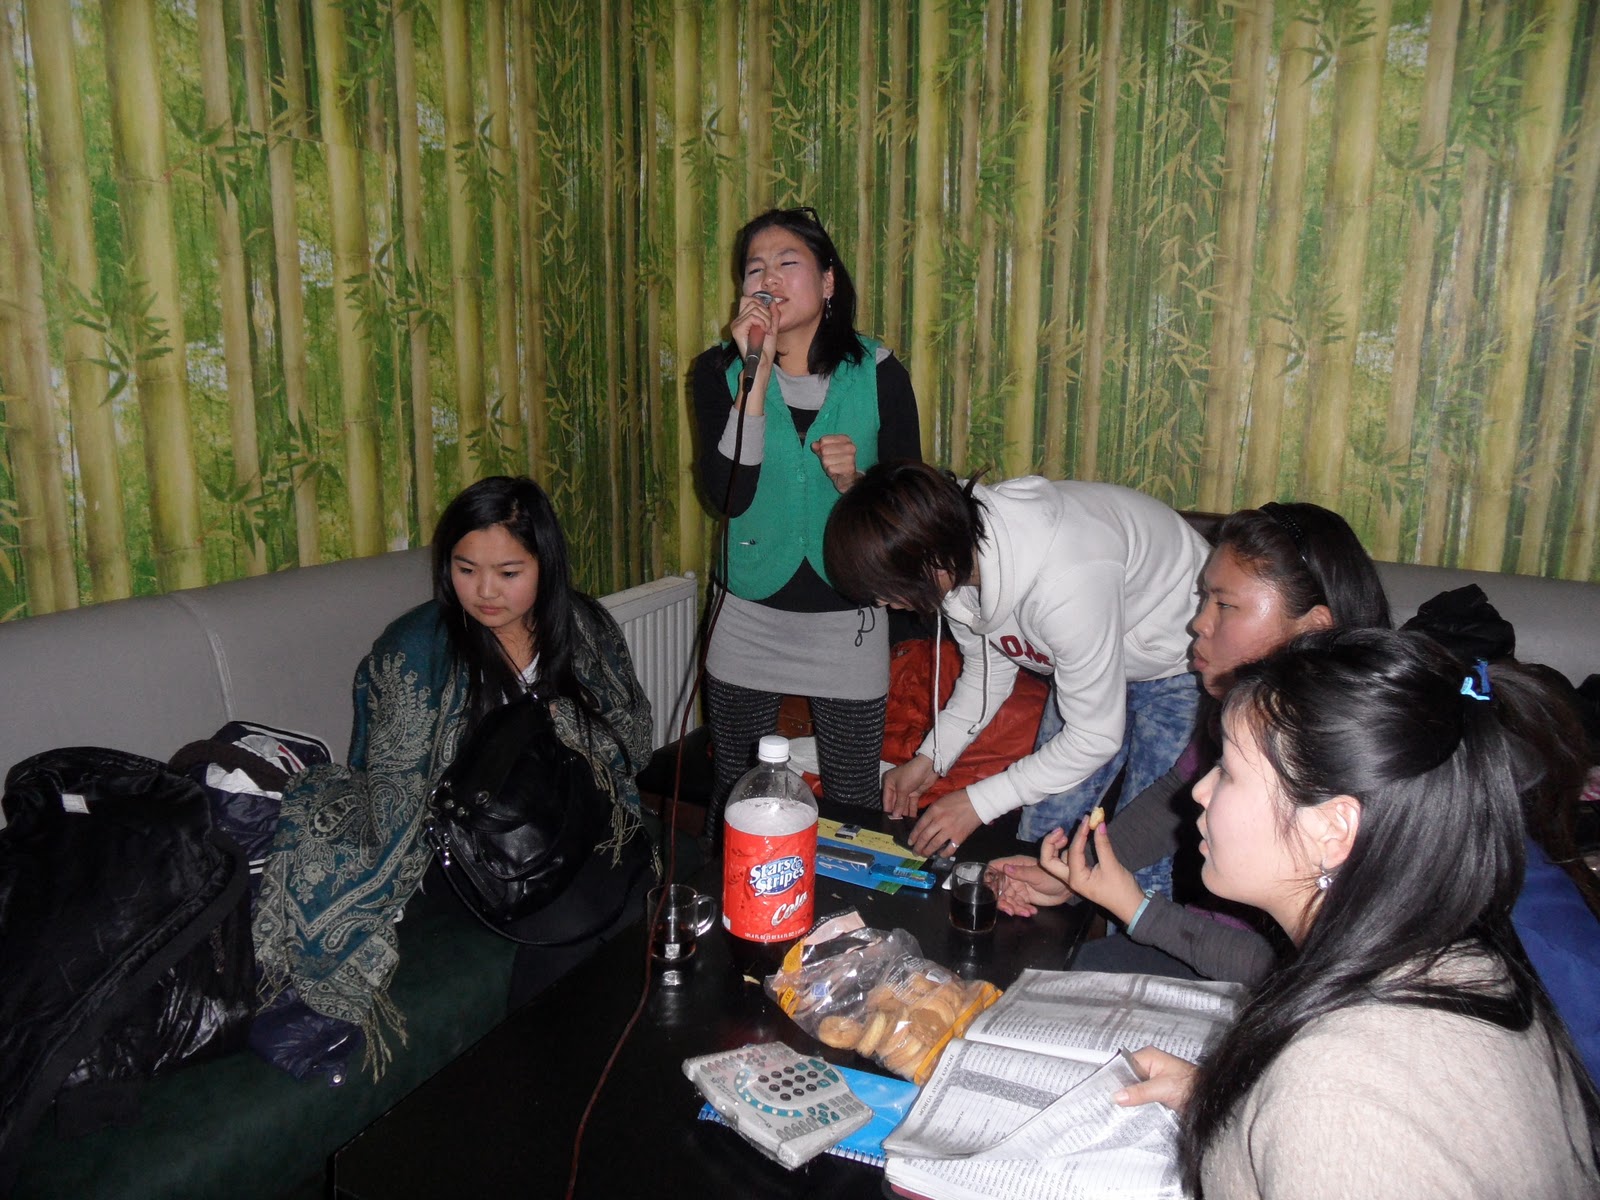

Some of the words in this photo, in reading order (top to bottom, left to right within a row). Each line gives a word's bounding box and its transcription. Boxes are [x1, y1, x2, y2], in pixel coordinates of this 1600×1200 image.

[749, 859, 791, 884] Stars
[754, 867, 805, 897] Stripes
[771, 891, 808, 926] Cola
